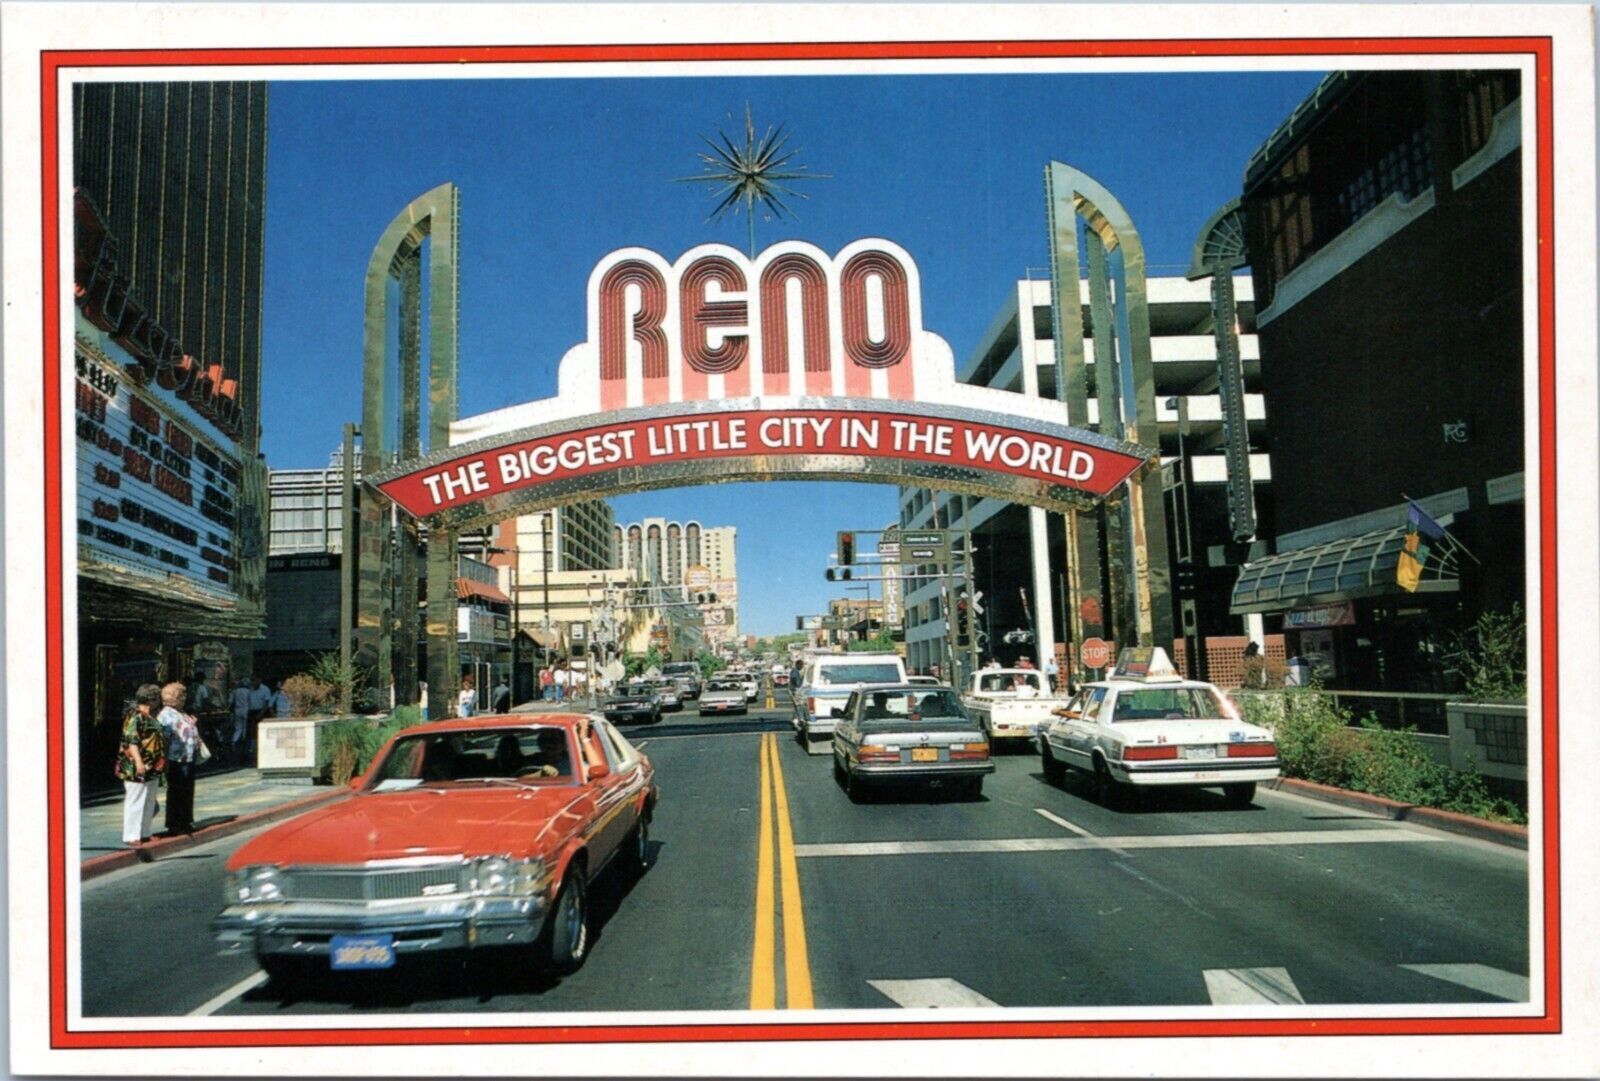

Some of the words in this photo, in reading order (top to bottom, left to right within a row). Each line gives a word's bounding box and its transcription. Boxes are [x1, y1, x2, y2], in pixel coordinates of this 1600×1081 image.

[599, 249, 912, 382] RENO
[422, 460, 490, 506] THE
[498, 429, 637, 485] BIGGEST
[647, 419, 747, 456] LITTLE
[759, 417, 833, 448] CITY
[840, 418, 879, 449] IN
[890, 420, 954, 456] THE
[964, 429, 1096, 482] WORLD
[1083, 647, 1107, 660] STOP
